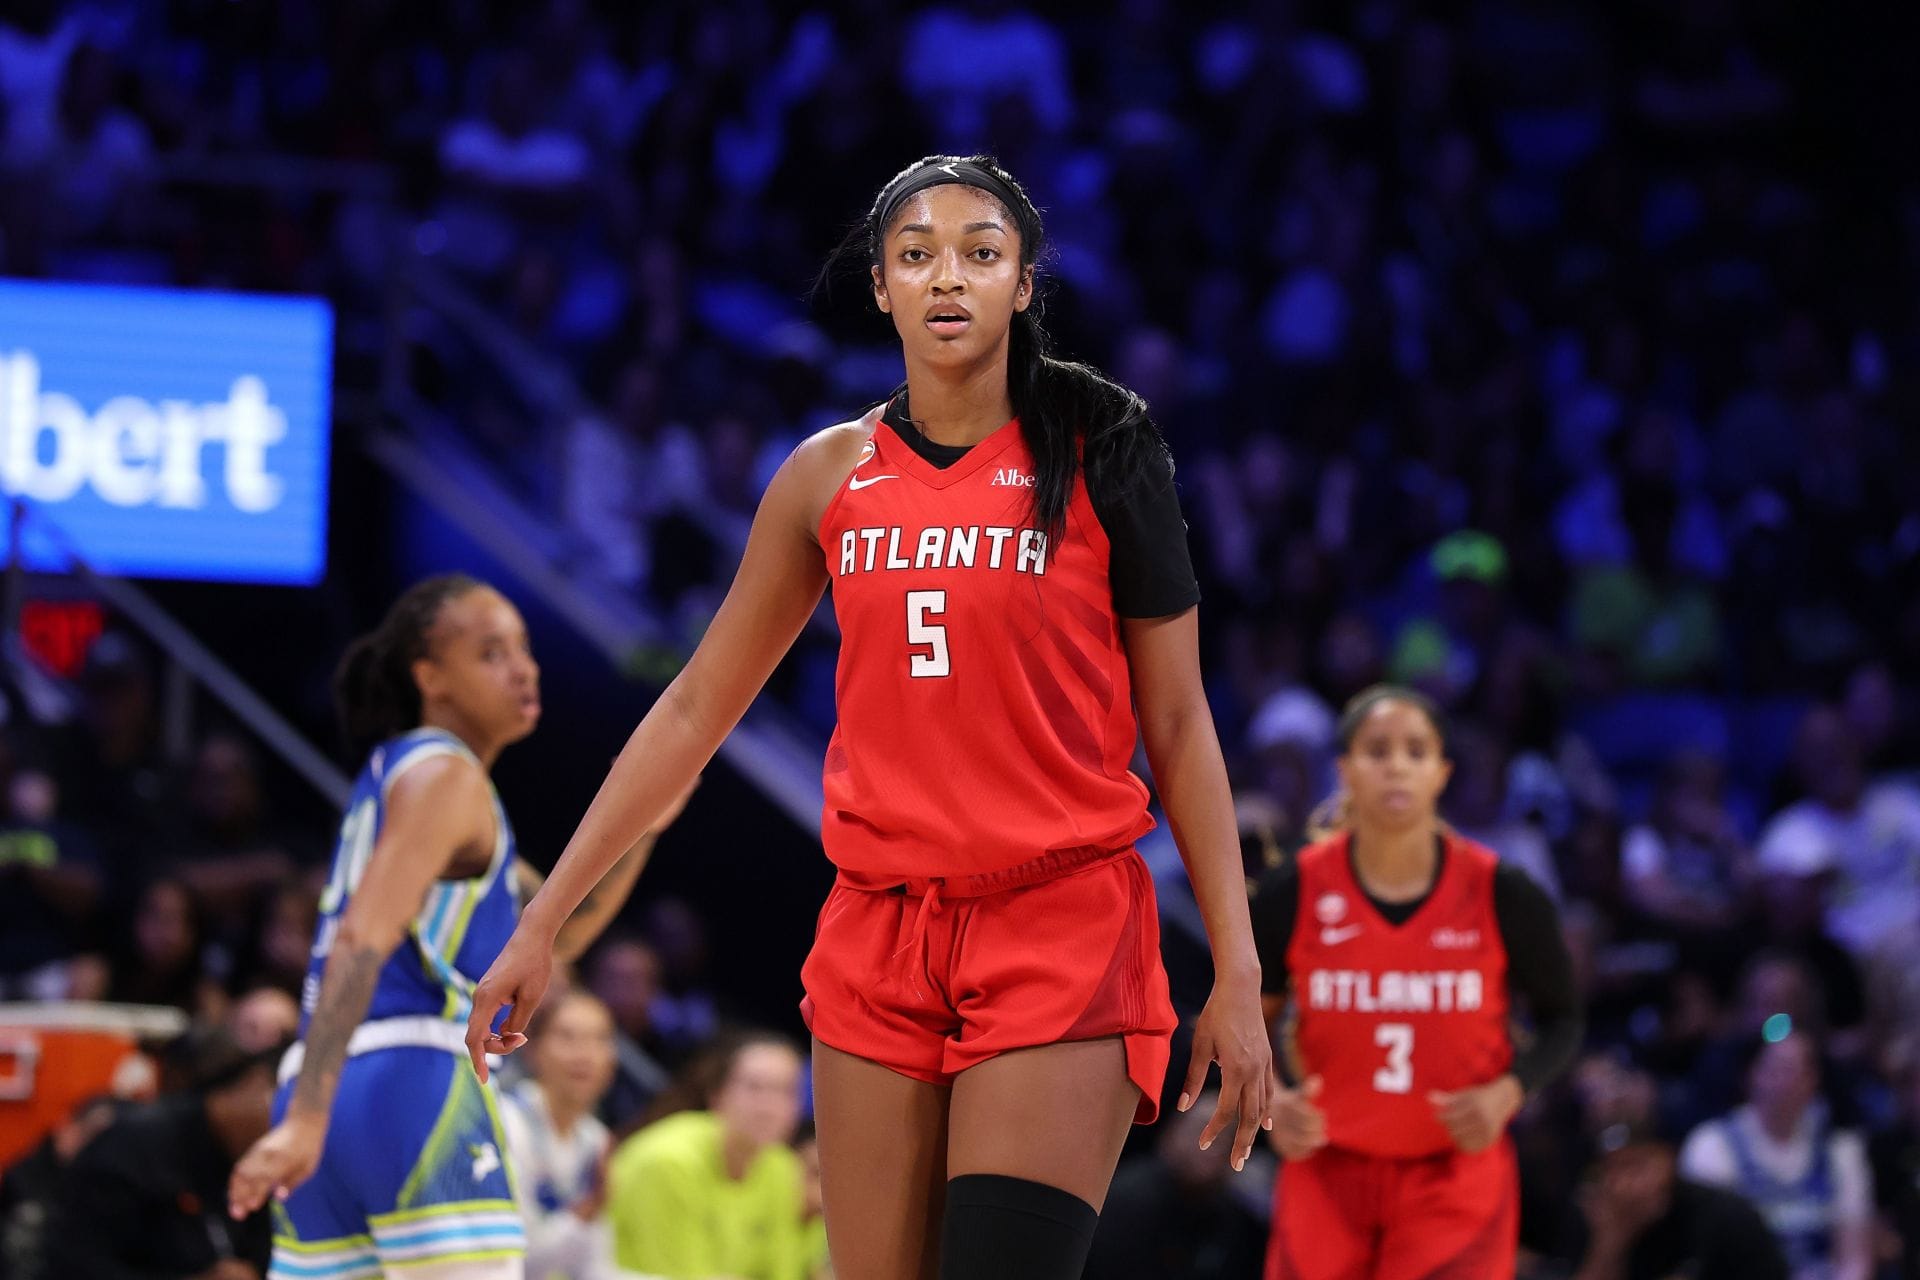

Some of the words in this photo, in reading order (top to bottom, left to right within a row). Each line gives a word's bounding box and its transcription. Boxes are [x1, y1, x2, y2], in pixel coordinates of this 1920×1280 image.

[0, 349, 286, 512] bert
[839, 526, 1048, 576] ATLANTA
[906, 590, 950, 678] 5
[1309, 969, 1484, 1013] ATLANTA
[1374, 1022, 1414, 1094] 3
